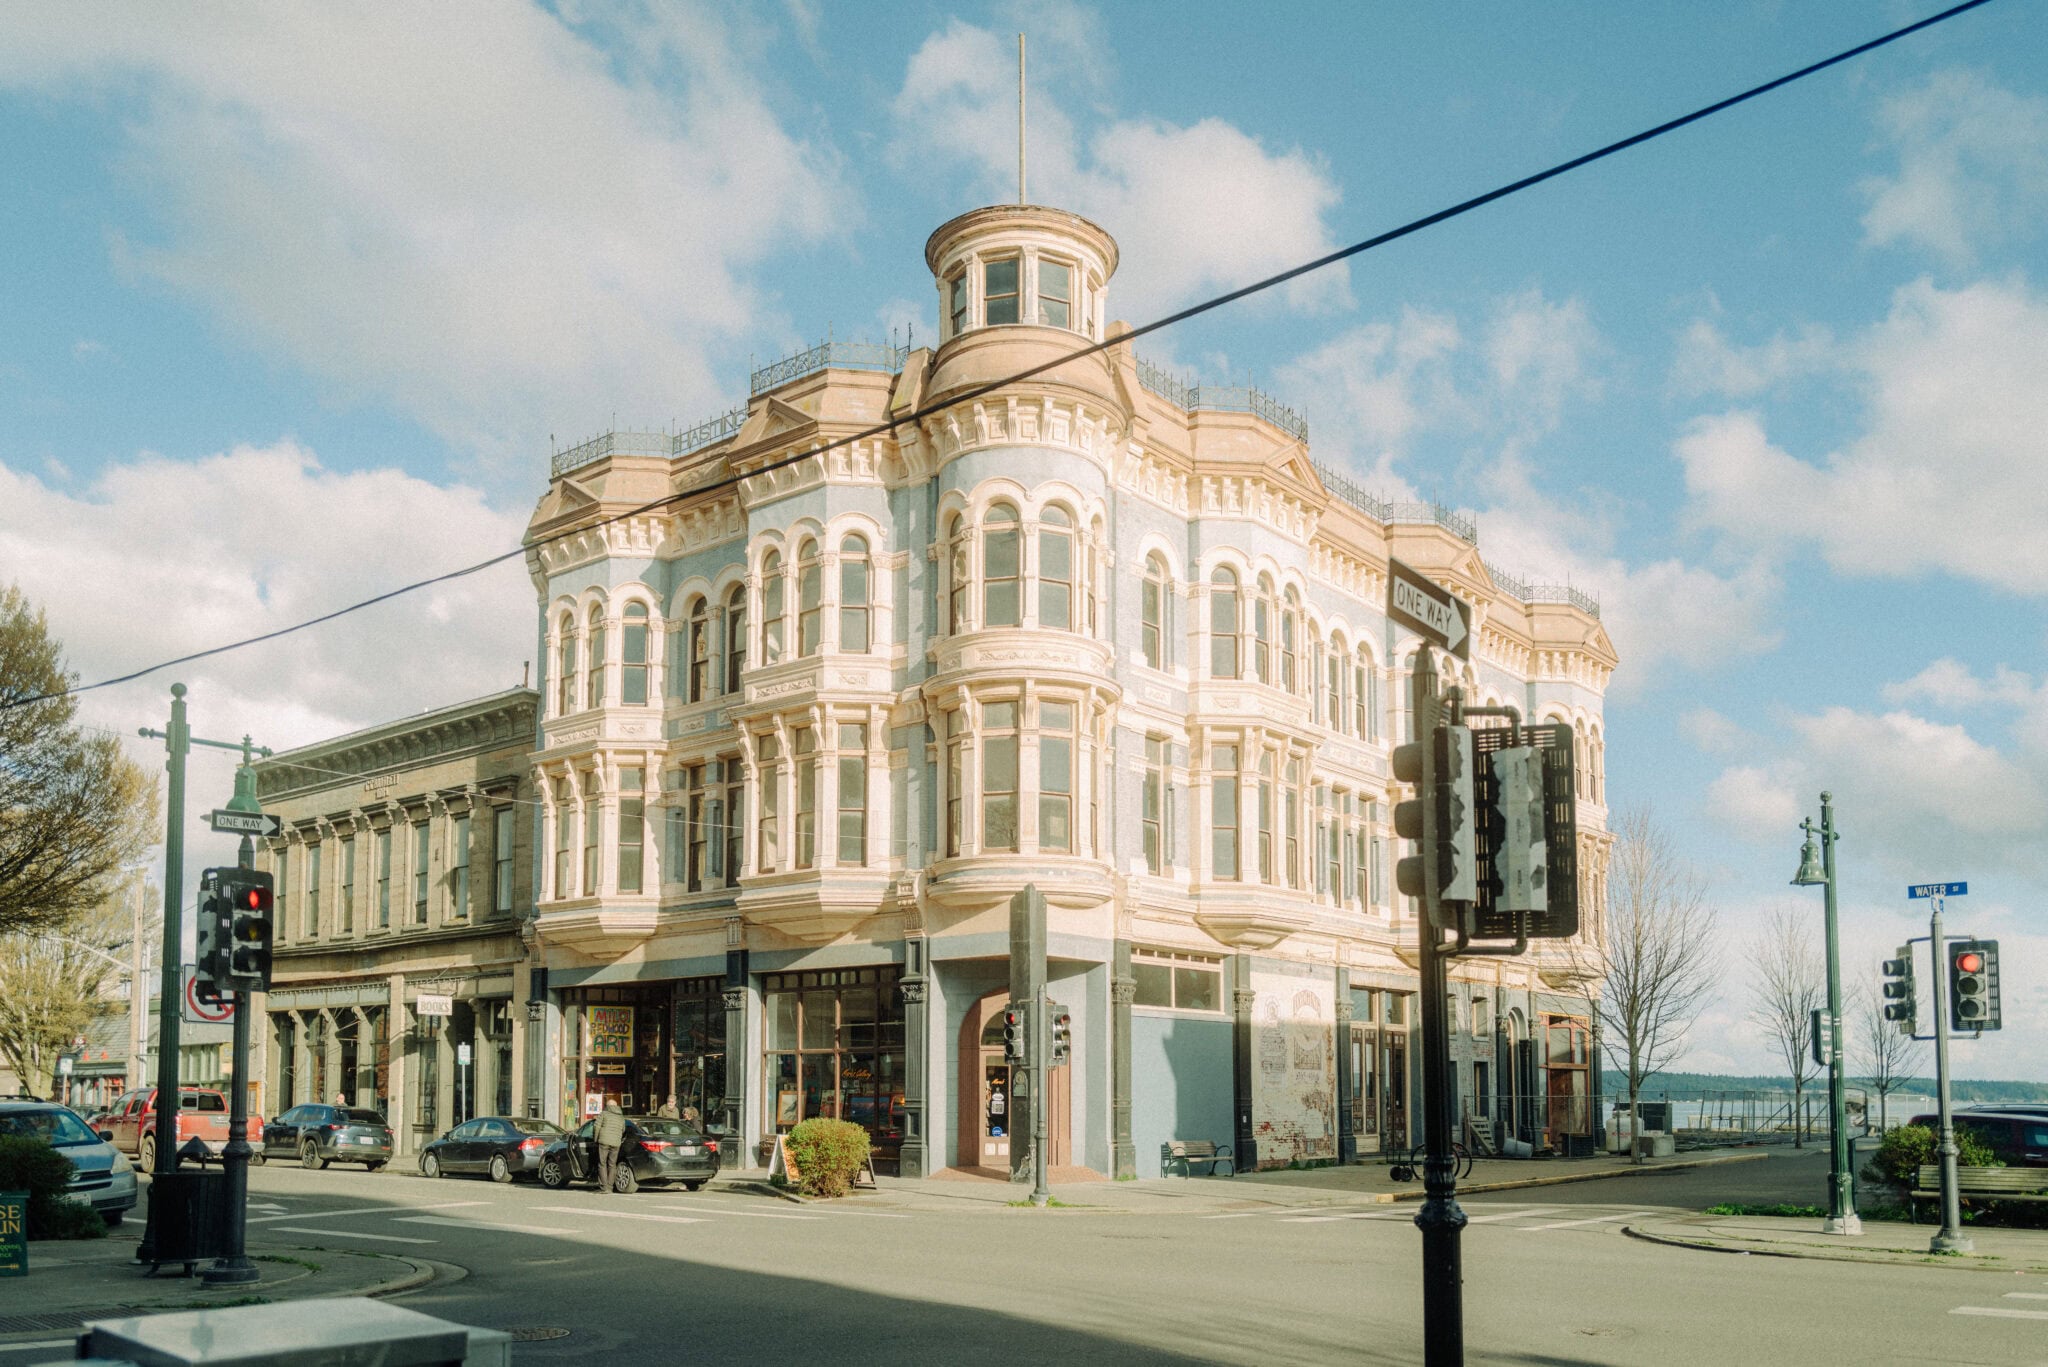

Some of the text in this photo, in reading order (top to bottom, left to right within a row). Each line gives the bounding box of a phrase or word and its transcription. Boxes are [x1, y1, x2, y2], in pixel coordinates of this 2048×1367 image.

[1397, 583, 1452, 632] ONE WAY
[219, 816, 261, 829] ONE WAY
[1914, 885, 1947, 897] WATER
[420, 1001, 450, 1012] BOOKS
[594, 1008, 631, 1023] MILO
[593, 1034, 630, 1054] ART
